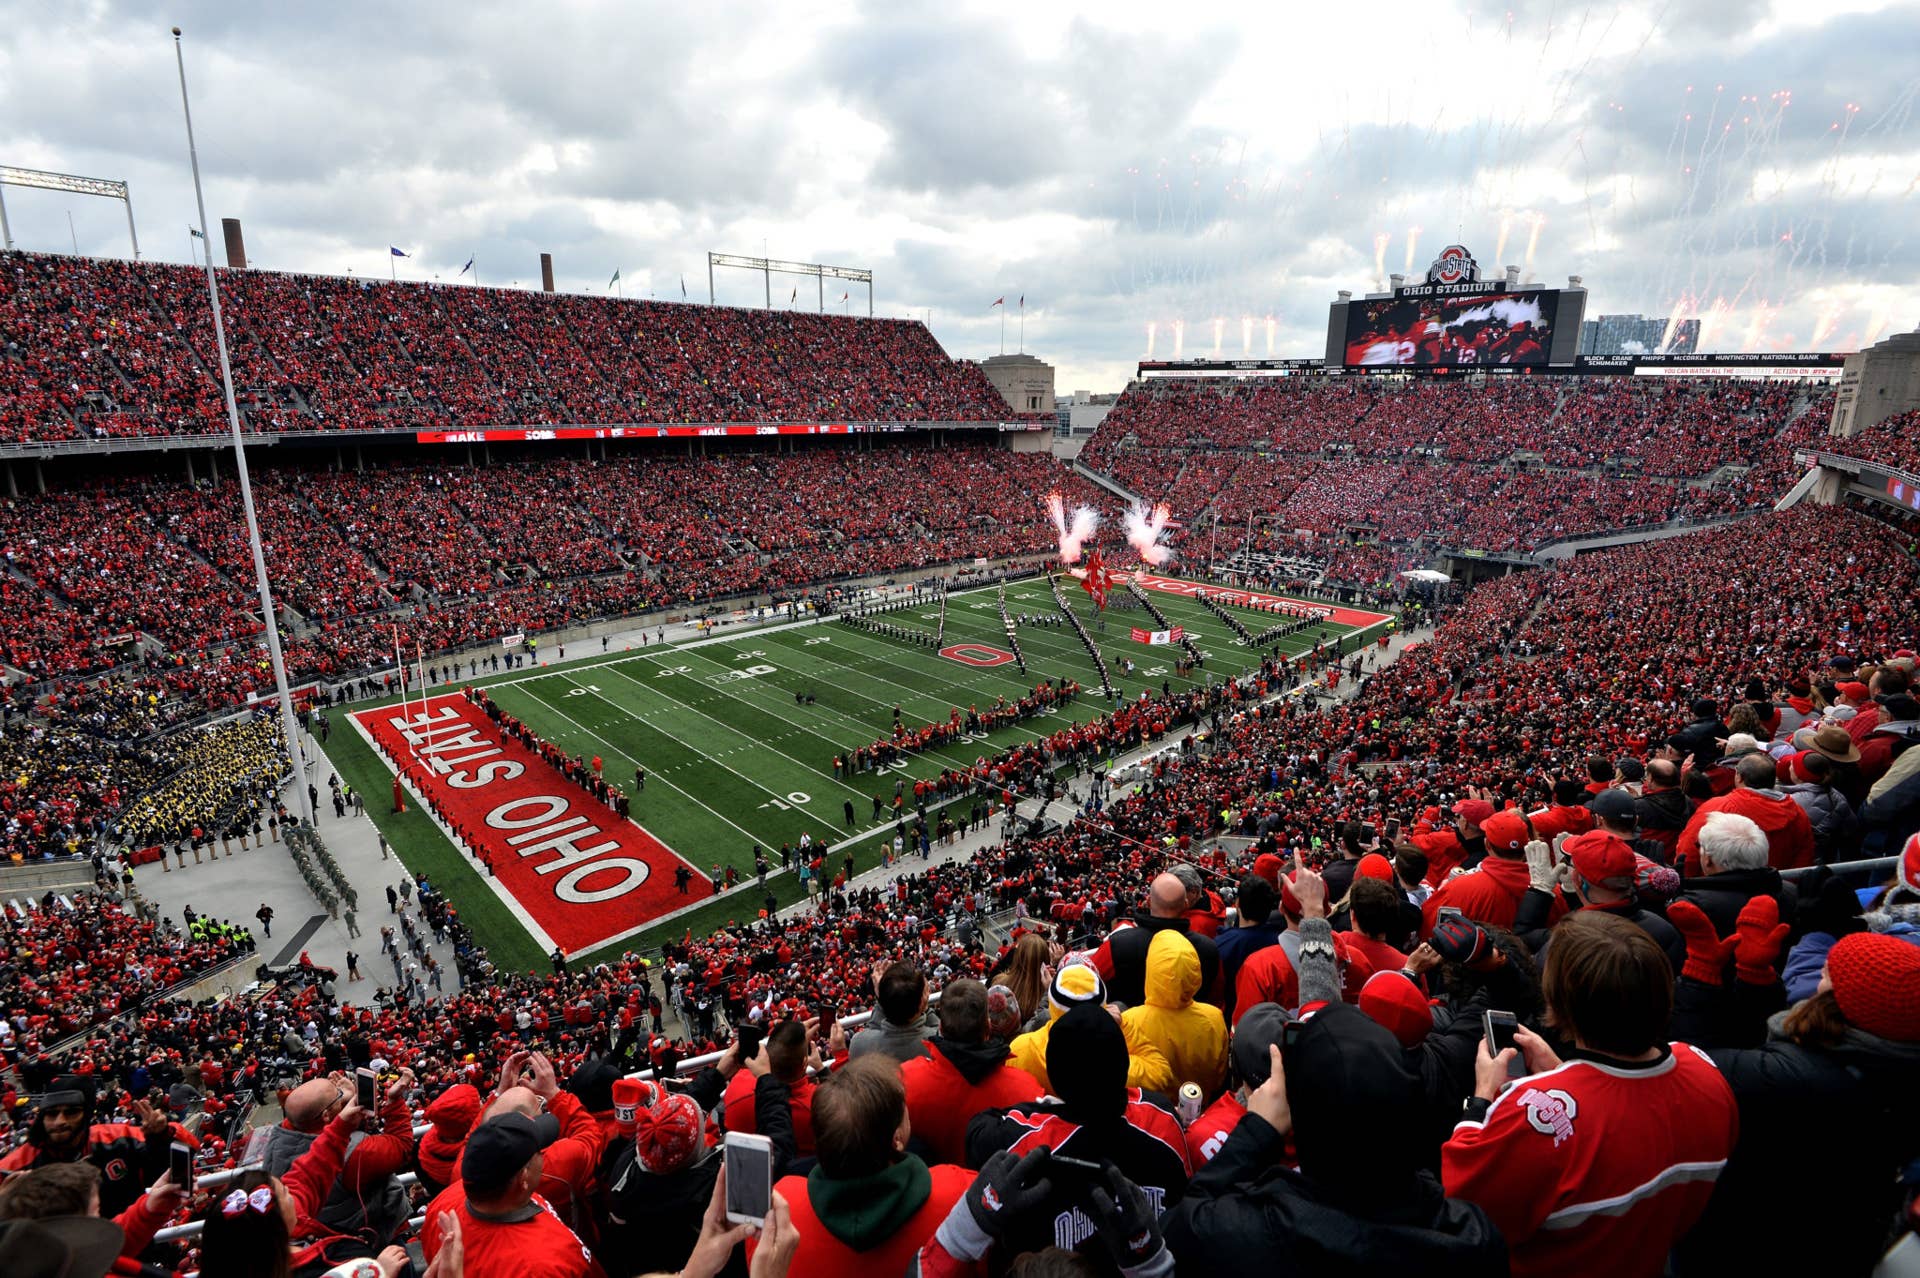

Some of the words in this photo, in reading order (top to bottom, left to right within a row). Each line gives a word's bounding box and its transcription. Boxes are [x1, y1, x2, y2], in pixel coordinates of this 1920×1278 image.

[1403, 286, 1432, 296] OHIO
[1436, 282, 1496, 294] STADIUM
[445, 431, 485, 442] MAKE
[737, 650, 767, 661] 30
[659, 666, 692, 677] 20
[570, 685, 601, 696] 10
[388, 705, 526, 789] STATE
[769, 791, 812, 811] 10
[484, 795, 651, 904] OHIO
[201, 1148, 217, 1159] 32
